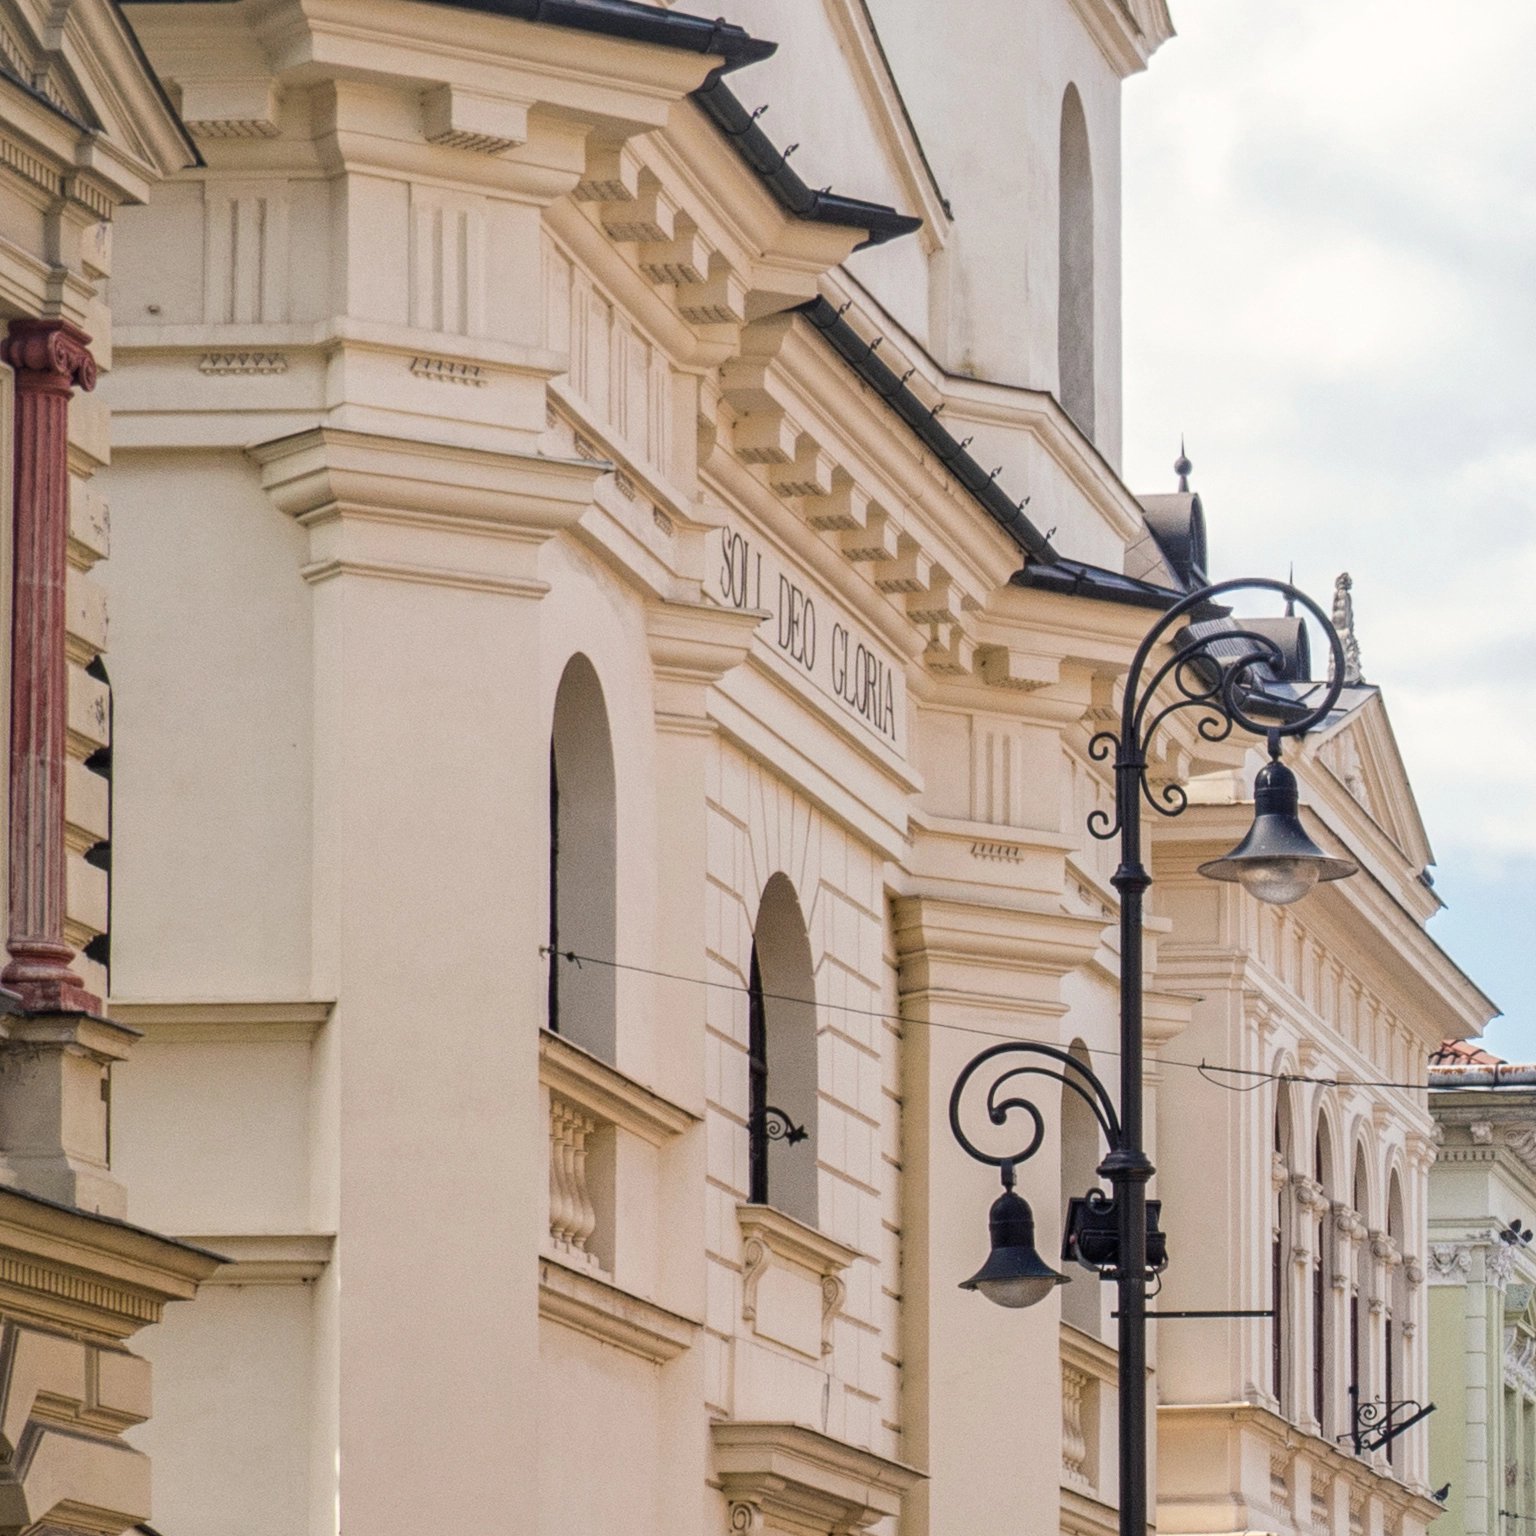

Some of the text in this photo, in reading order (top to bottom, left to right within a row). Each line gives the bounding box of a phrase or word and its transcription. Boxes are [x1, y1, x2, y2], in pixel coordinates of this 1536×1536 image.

[720, 525, 896, 741] SOLI DEO GLORIA
